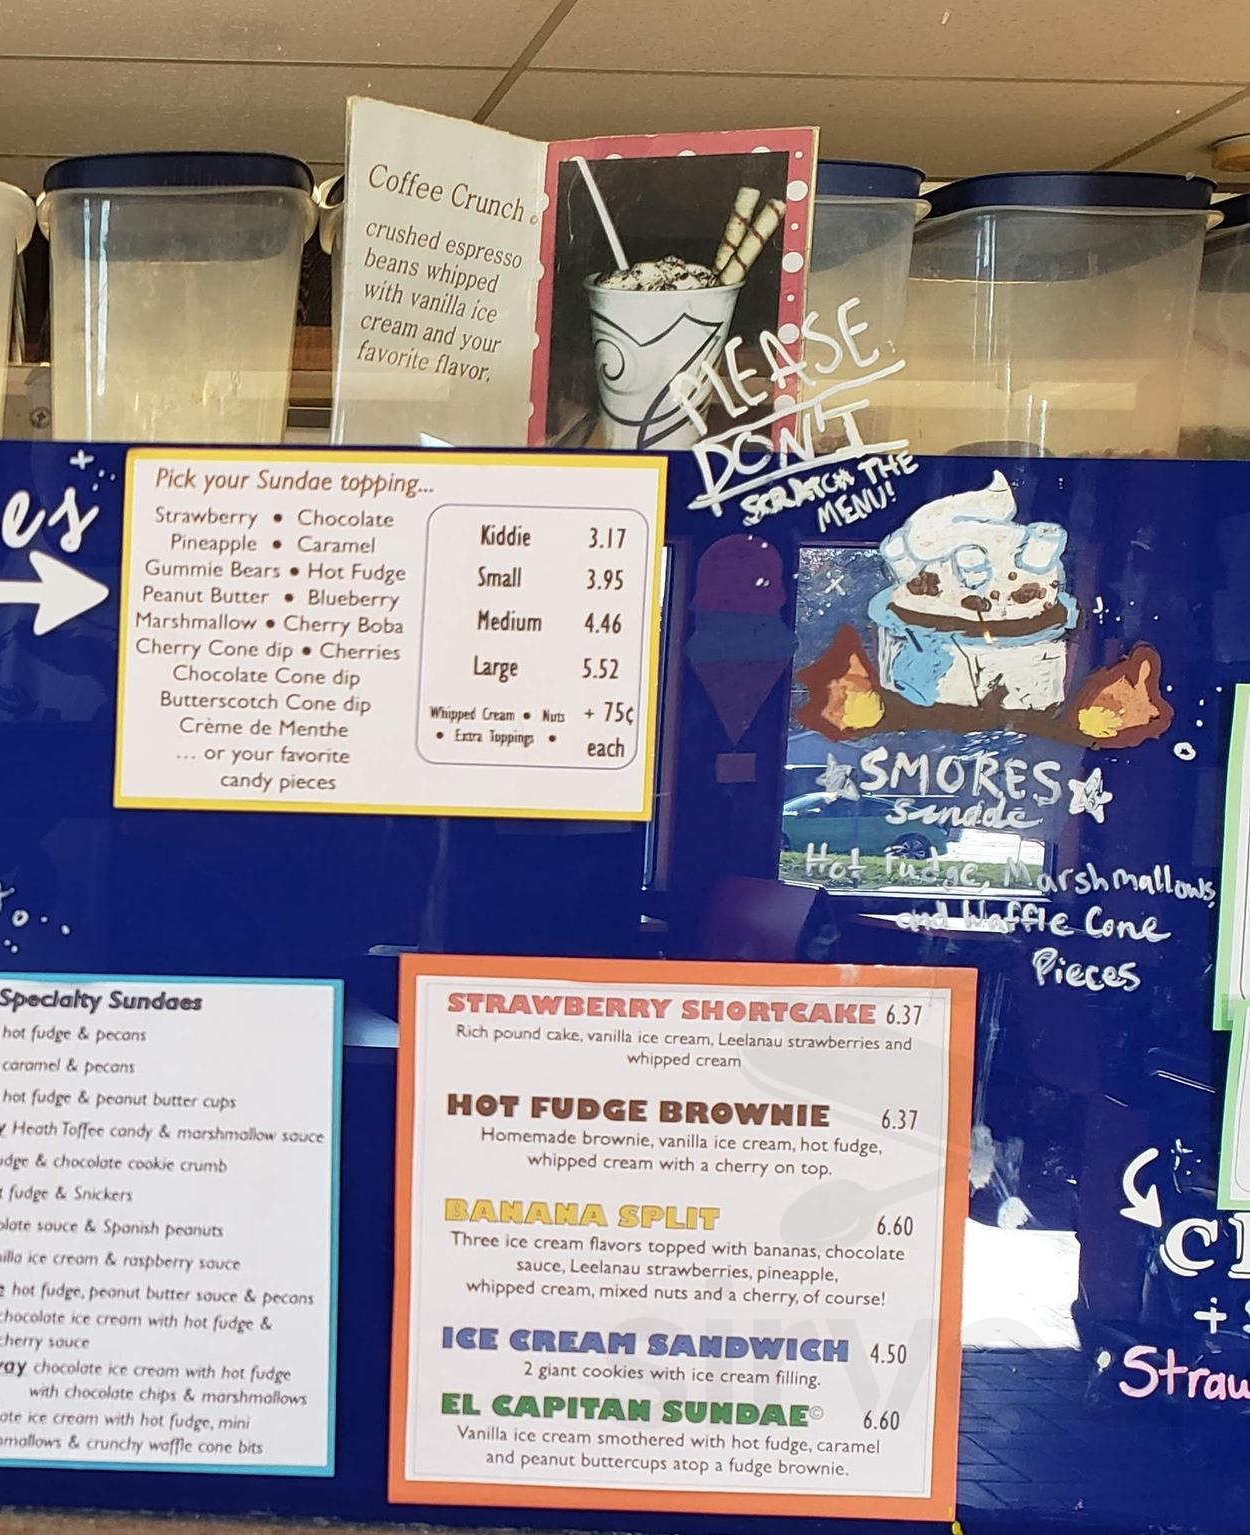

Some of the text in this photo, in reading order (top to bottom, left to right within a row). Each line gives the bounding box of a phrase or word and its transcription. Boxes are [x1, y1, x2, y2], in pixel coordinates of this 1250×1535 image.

[369, 164, 526, 222] Coffee Crunch
[366, 223, 523, 269] crushed espresso
[365, 248, 500, 294] beans whipped
[365, 281, 497, 323] with vanilla ice
[361, 315, 501, 353] cream and your
[357, 341, 489, 382] favorite flavor.
[669, 296, 880, 435] PLEASE
[692, 399, 872, 512] DON'T
[156, 468, 433, 498] Pick your Sundae topping...
[740, 450, 919, 526] SCRATCH THE
[156, 506, 394, 530] Strawberry Chocolate
[817, 482, 897, 533] MENU!
[171, 533, 375, 556] Pineapple Caramel
[481, 524, 626, 549] Kiddie 3.17
[478, 566, 623, 590] Small 3.95
[136, 612, 403, 637] Marshmallow Cherry Boba
[478, 609, 621, 634] Medium 4.46
[473, 655, 618, 683] Large 5.52
[221, 772, 336, 793] candy pieces
[859, 746, 1063, 806] SMORES
[806, 842, 867, 881] Hot
[896, 900, 1172, 942] and Waffle Cone
[1032, 947, 1142, 992] Pieces
[108, 990, 203, 1011] Sundaes
[447, 992, 922, 1025] STRAWBERRY SHORTCAKE 6.37
[2, 1025, 26, 1040] hot
[31, 1024, 71, 1044] fudge
[77, 1026, 89, 1040] &
[96, 1029, 146, 1044] pecans
[2, 1058, 61, 1072] caramel
[66, 1057, 78, 1072] &
[84, 1061, 134, 1076] pecans
[447, 1093, 918, 1130] HOT FUDGE BROWNIE 6.37
[444, 1198, 913, 1236] BANANA SPLIT 6.60
[28, 1254, 47, 1264] ice
[53, 1254, 98, 1265] cream
[105, 1251, 116, 1266] &
[123, 1253, 193, 1272] raspberry
[200, 1259, 240, 1270] sauce
[442, 1326, 907, 1364] ICE CREAM SANDWICH 4.50
[524, 1361, 821, 1389] 2 giant cookies with ice cream filling.
[441, 1392, 481, 1416] EL
[491, 1394, 651, 1422] CAPITAN
[863, 1410, 899, 1430] 6.60
